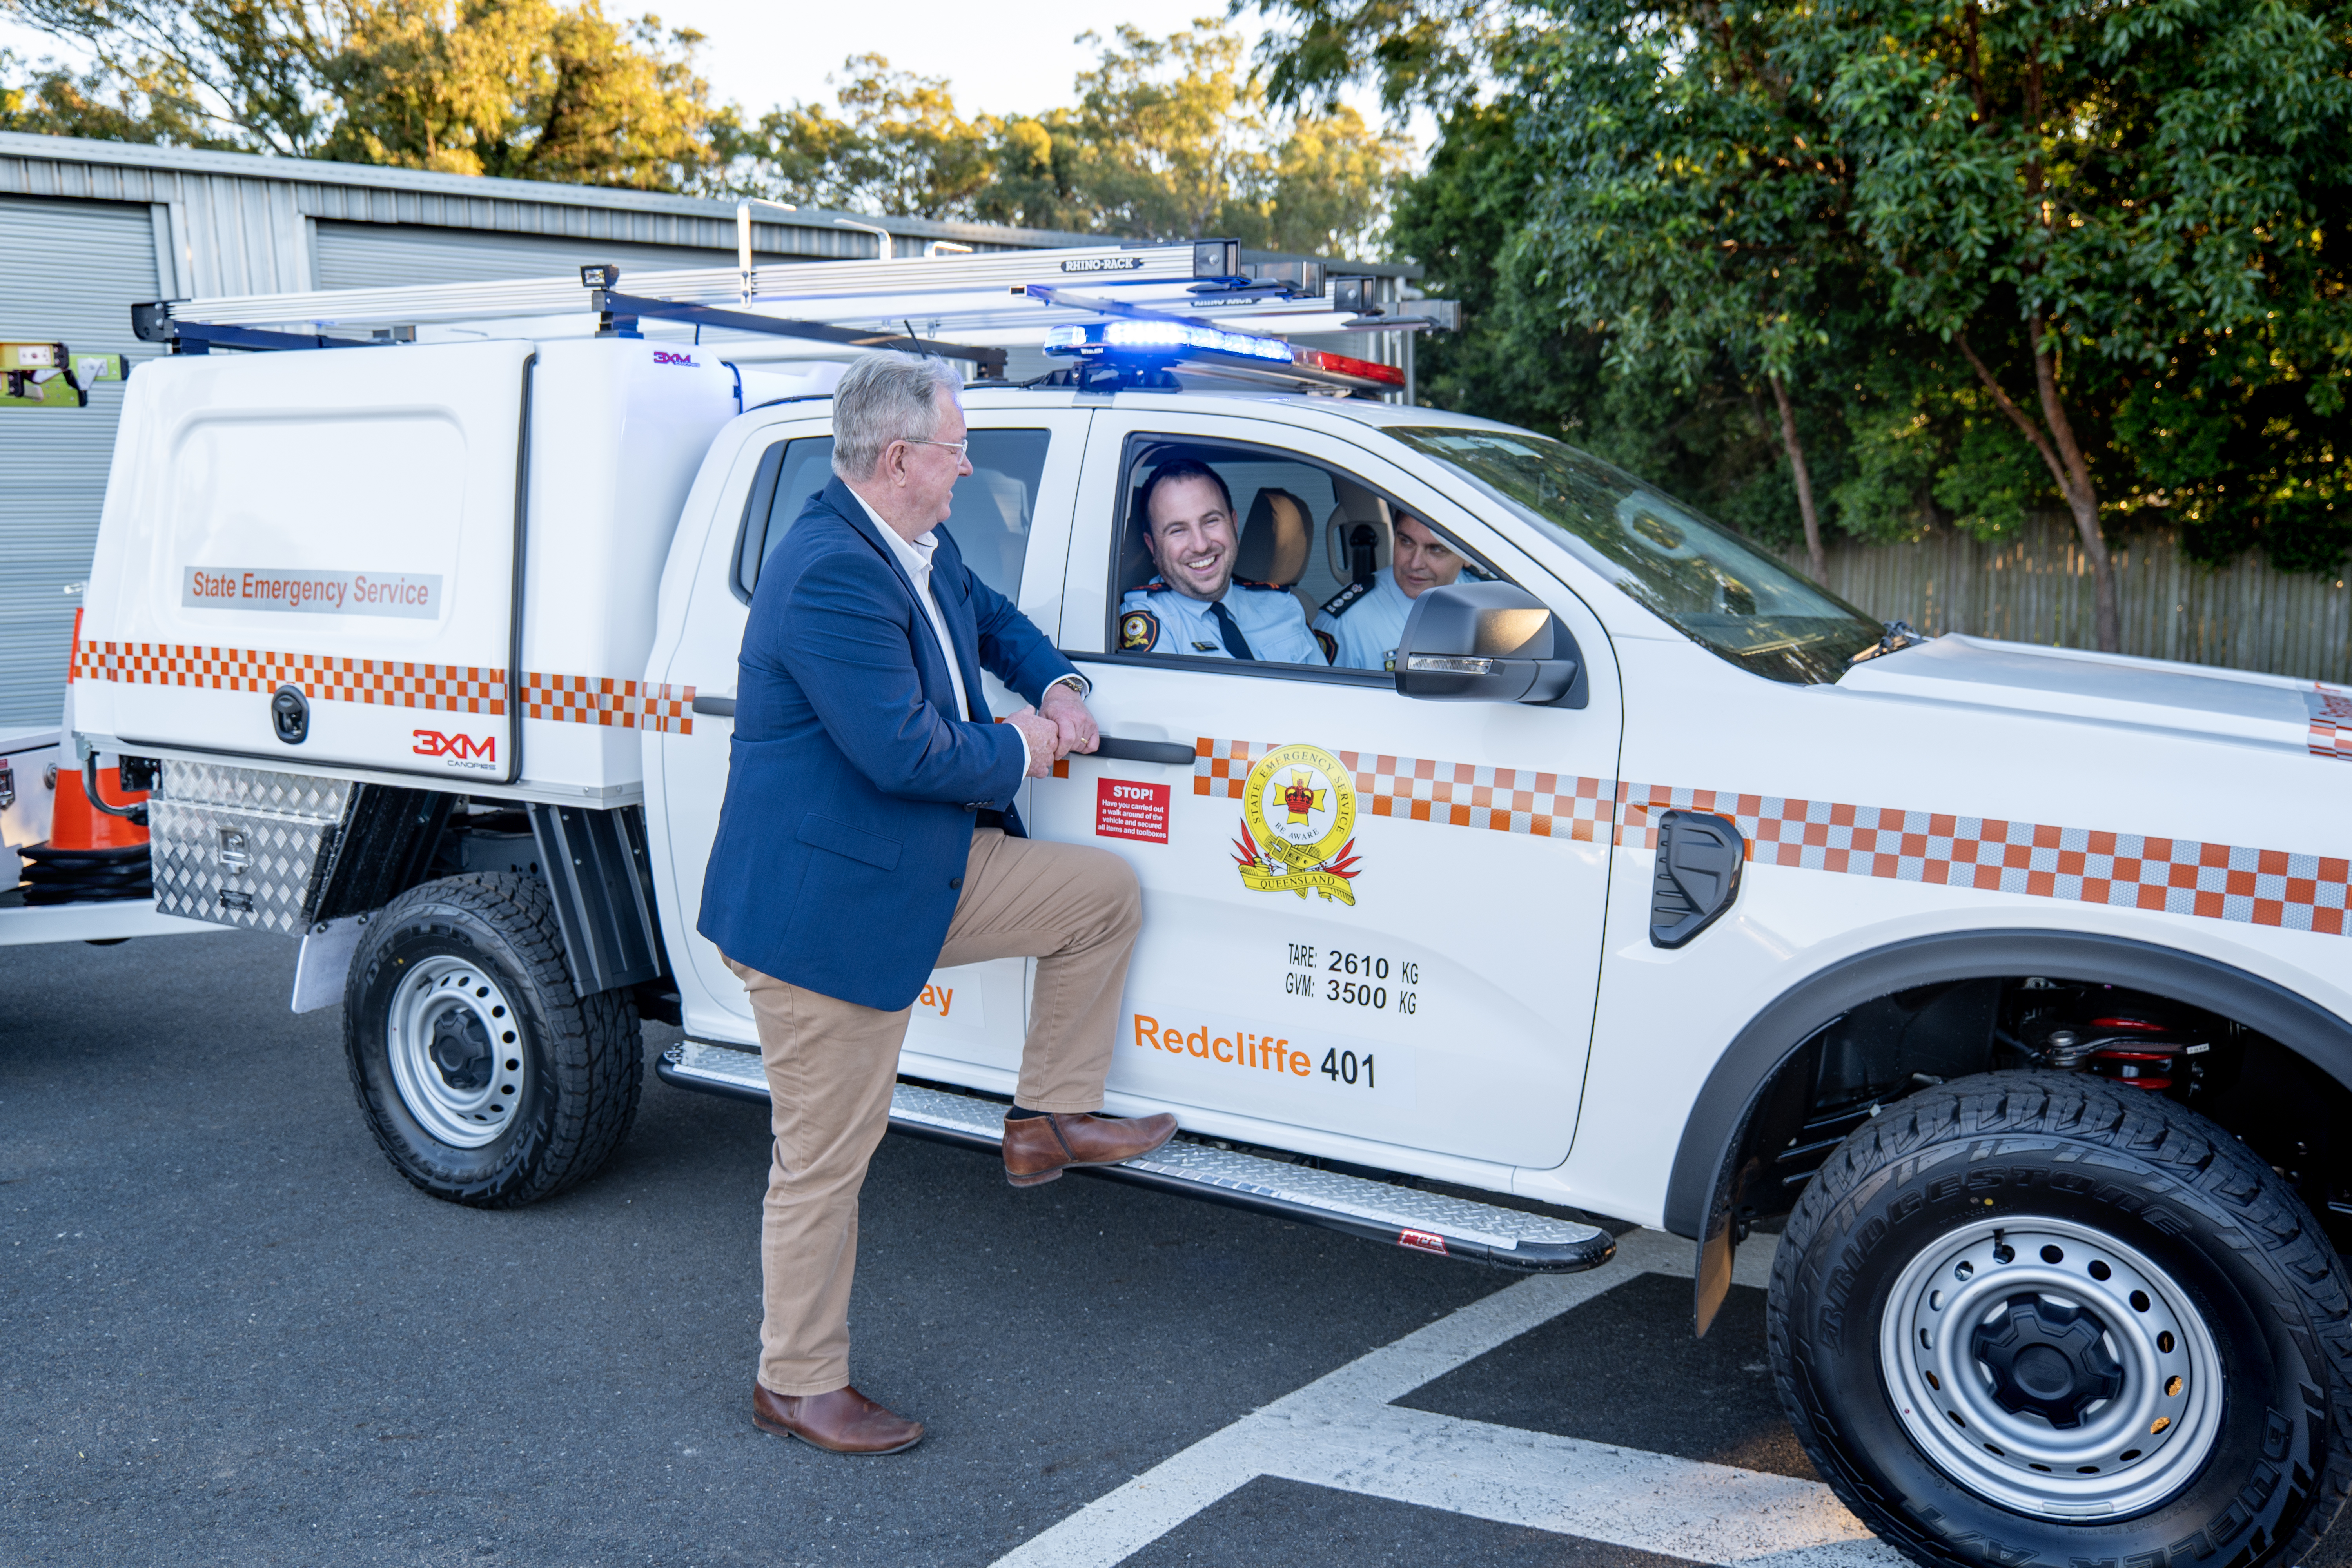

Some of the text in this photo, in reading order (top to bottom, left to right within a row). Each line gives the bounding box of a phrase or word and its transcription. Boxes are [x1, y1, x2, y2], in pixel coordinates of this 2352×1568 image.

[1065, 258, 1134, 271] RHINO-RACK
[653, 351, 691, 365] 3XM
[192, 571, 428, 608] State Emergency Service
[413, 730, 495, 762] 3XM
[448, 760, 496, 770] CANOPIES
[1113, 785, 1154, 801] STOP!
[1251, 751, 1350, 834] STATE EMERGENCY SERVICE
[1136, 829, 1166, 838] toolboxes
[1275, 822, 1319, 840] BE AWARE
[1260, 875, 1335, 889] QUEENSLAND
[1289, 943, 1419, 984] TARE: 2610 KG
[913, 983, 953, 1017] ay
[1286, 972, 1417, 1014] GVM: 3500 KG
[1134, 1013, 1374, 1089] Redcliffe 401
[1819, 1165, 2193, 1357] BRIDGESTONE
